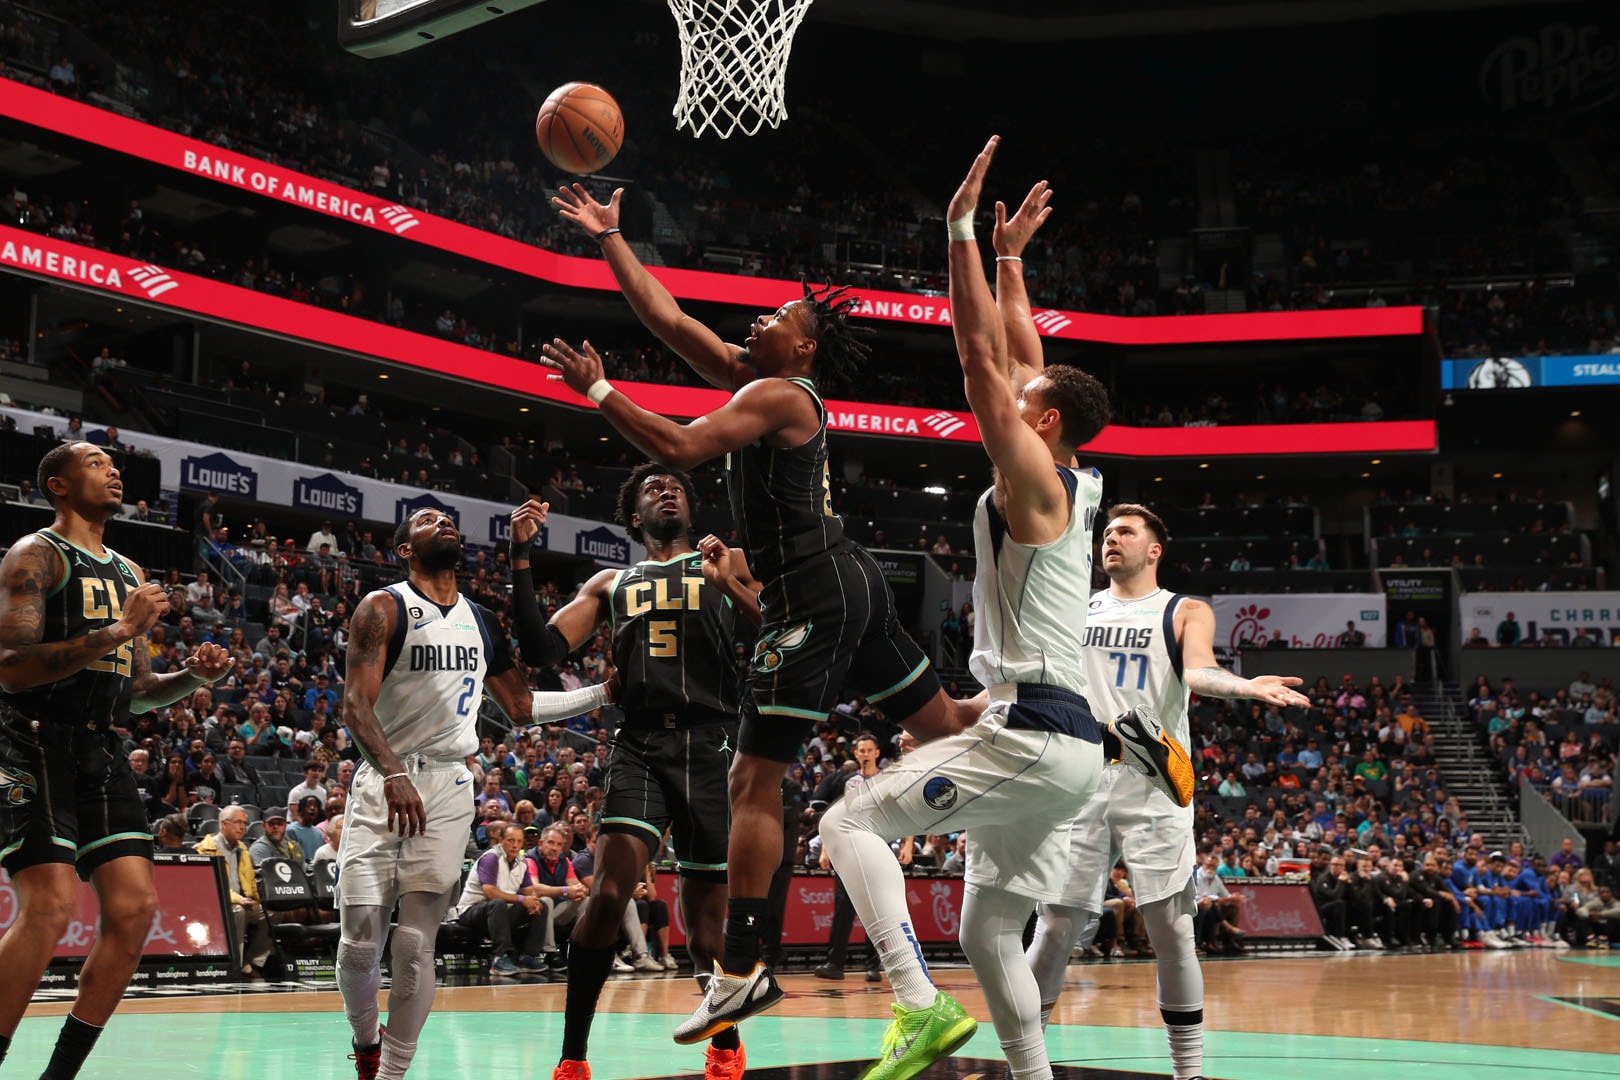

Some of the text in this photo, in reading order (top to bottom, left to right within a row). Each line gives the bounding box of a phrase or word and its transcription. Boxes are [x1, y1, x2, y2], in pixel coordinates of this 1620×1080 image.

[1538, 22, 1600, 66] Dr
[184, 150, 376, 225] BANK OF AMERICA
[0, 241, 122, 288] AMERICA
[849, 299, 904, 318] BANK
[908, 304, 935, 321] OF
[826, 411, 919, 434] AMERICA
[187, 462, 250, 494] LOWE'S
[300, 483, 356, 513] LOWE'S
[580, 542, 626, 561] LOWE'S
[624, 577, 705, 617] CLT
[1386, 579, 1423, 587] UTILITY
[78, 577, 137, 620] CL
[1550, 609, 1620, 622] CHAR
[649, 620, 677, 657] 5
[1082, 626, 1153, 648] DALLAS
[409, 645, 478, 672] DALLAS
[1109, 652, 1148, 690] 77
[456, 677, 475, 716] 2
[275, 886, 304, 895] wave
[156, 971, 189, 979] lendingtree
[195, 969, 228, 977] lendingtree
